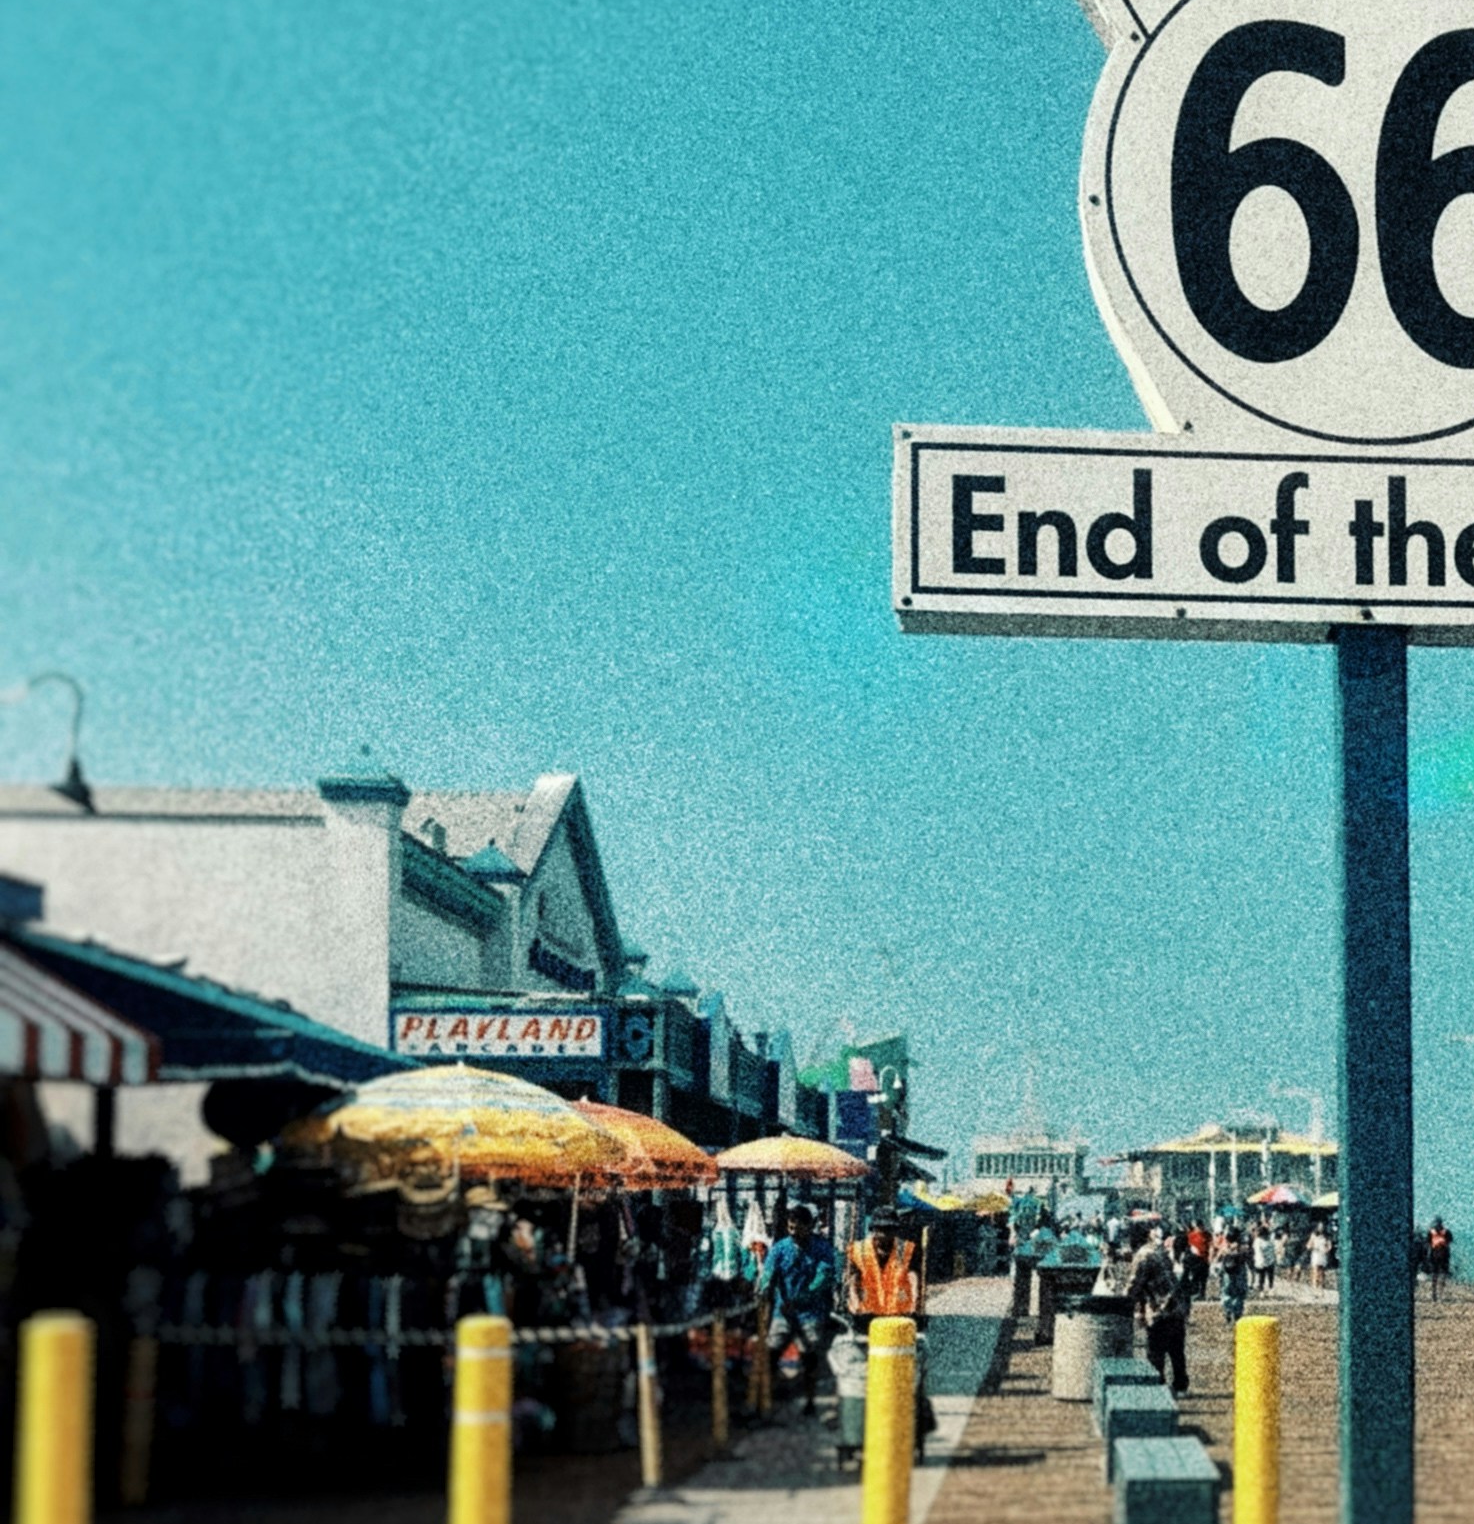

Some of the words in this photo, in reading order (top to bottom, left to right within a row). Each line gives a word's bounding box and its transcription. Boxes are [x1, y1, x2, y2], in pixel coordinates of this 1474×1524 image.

[951, 469, 1153, 580] End
[1198, 472, 1310, 584] of
[400, 1016, 597, 1041] PLAYLAND
